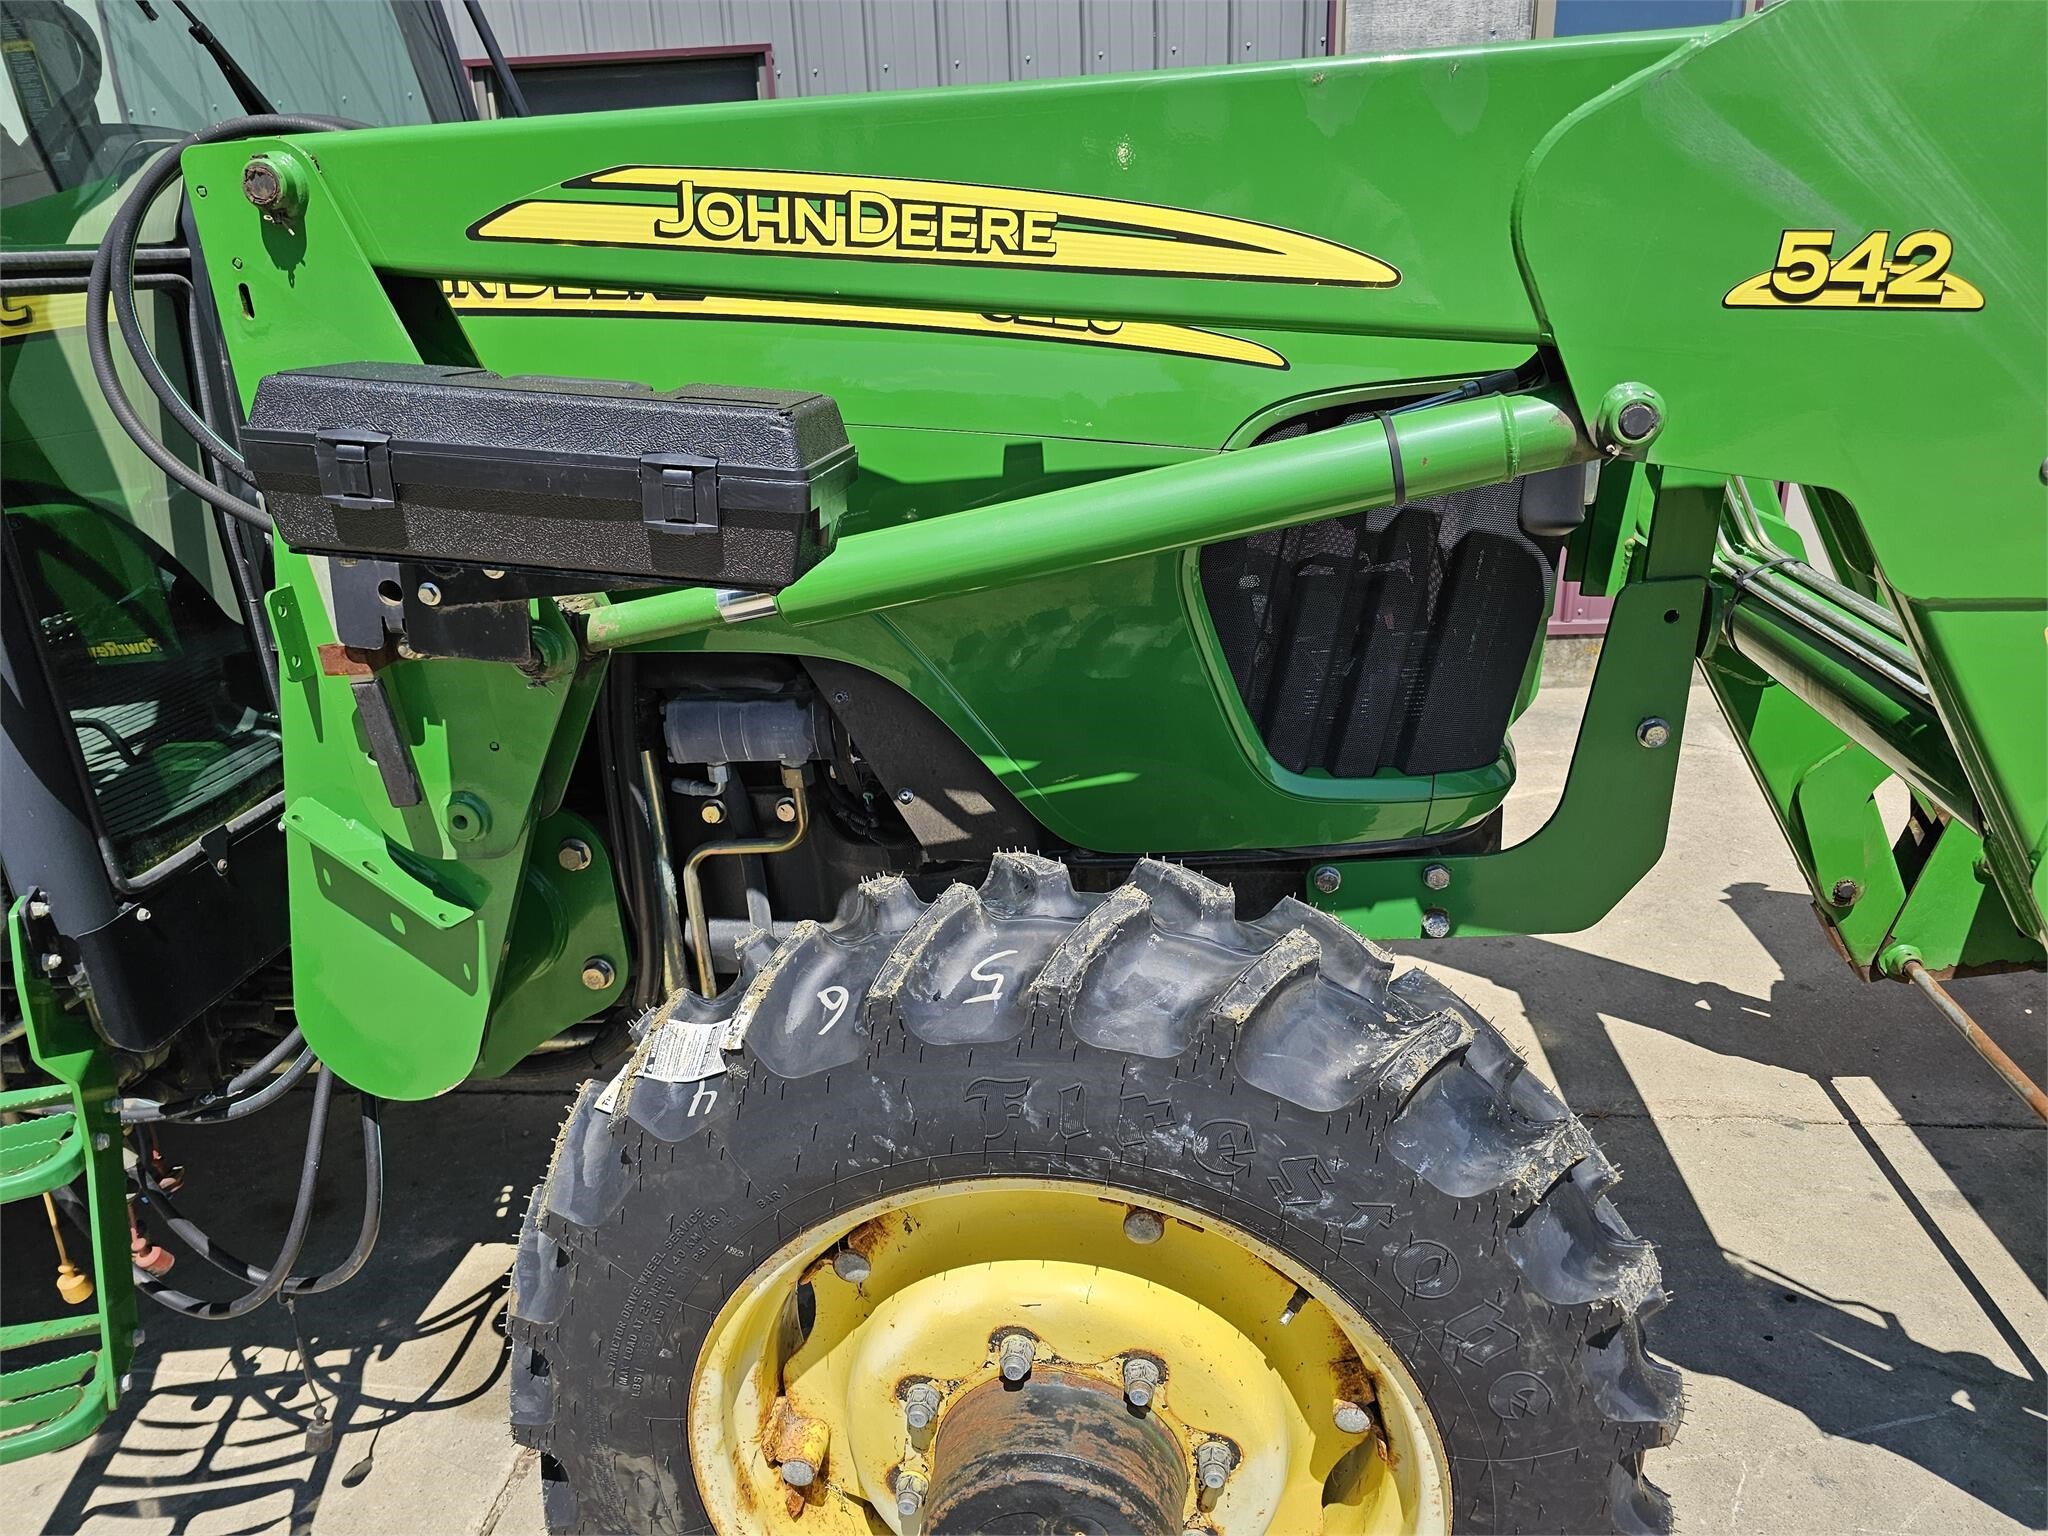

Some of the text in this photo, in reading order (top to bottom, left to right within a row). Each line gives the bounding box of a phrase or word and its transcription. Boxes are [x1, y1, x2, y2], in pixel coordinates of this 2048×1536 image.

[654, 179, 1058, 258] JOHN DEERE
[1770, 229, 1955, 304] 542
[608, 1207, 705, 1367] TRACTOR DRIVE WHEEL SERVICE
[623, 1334, 638, 1360] LOAD
